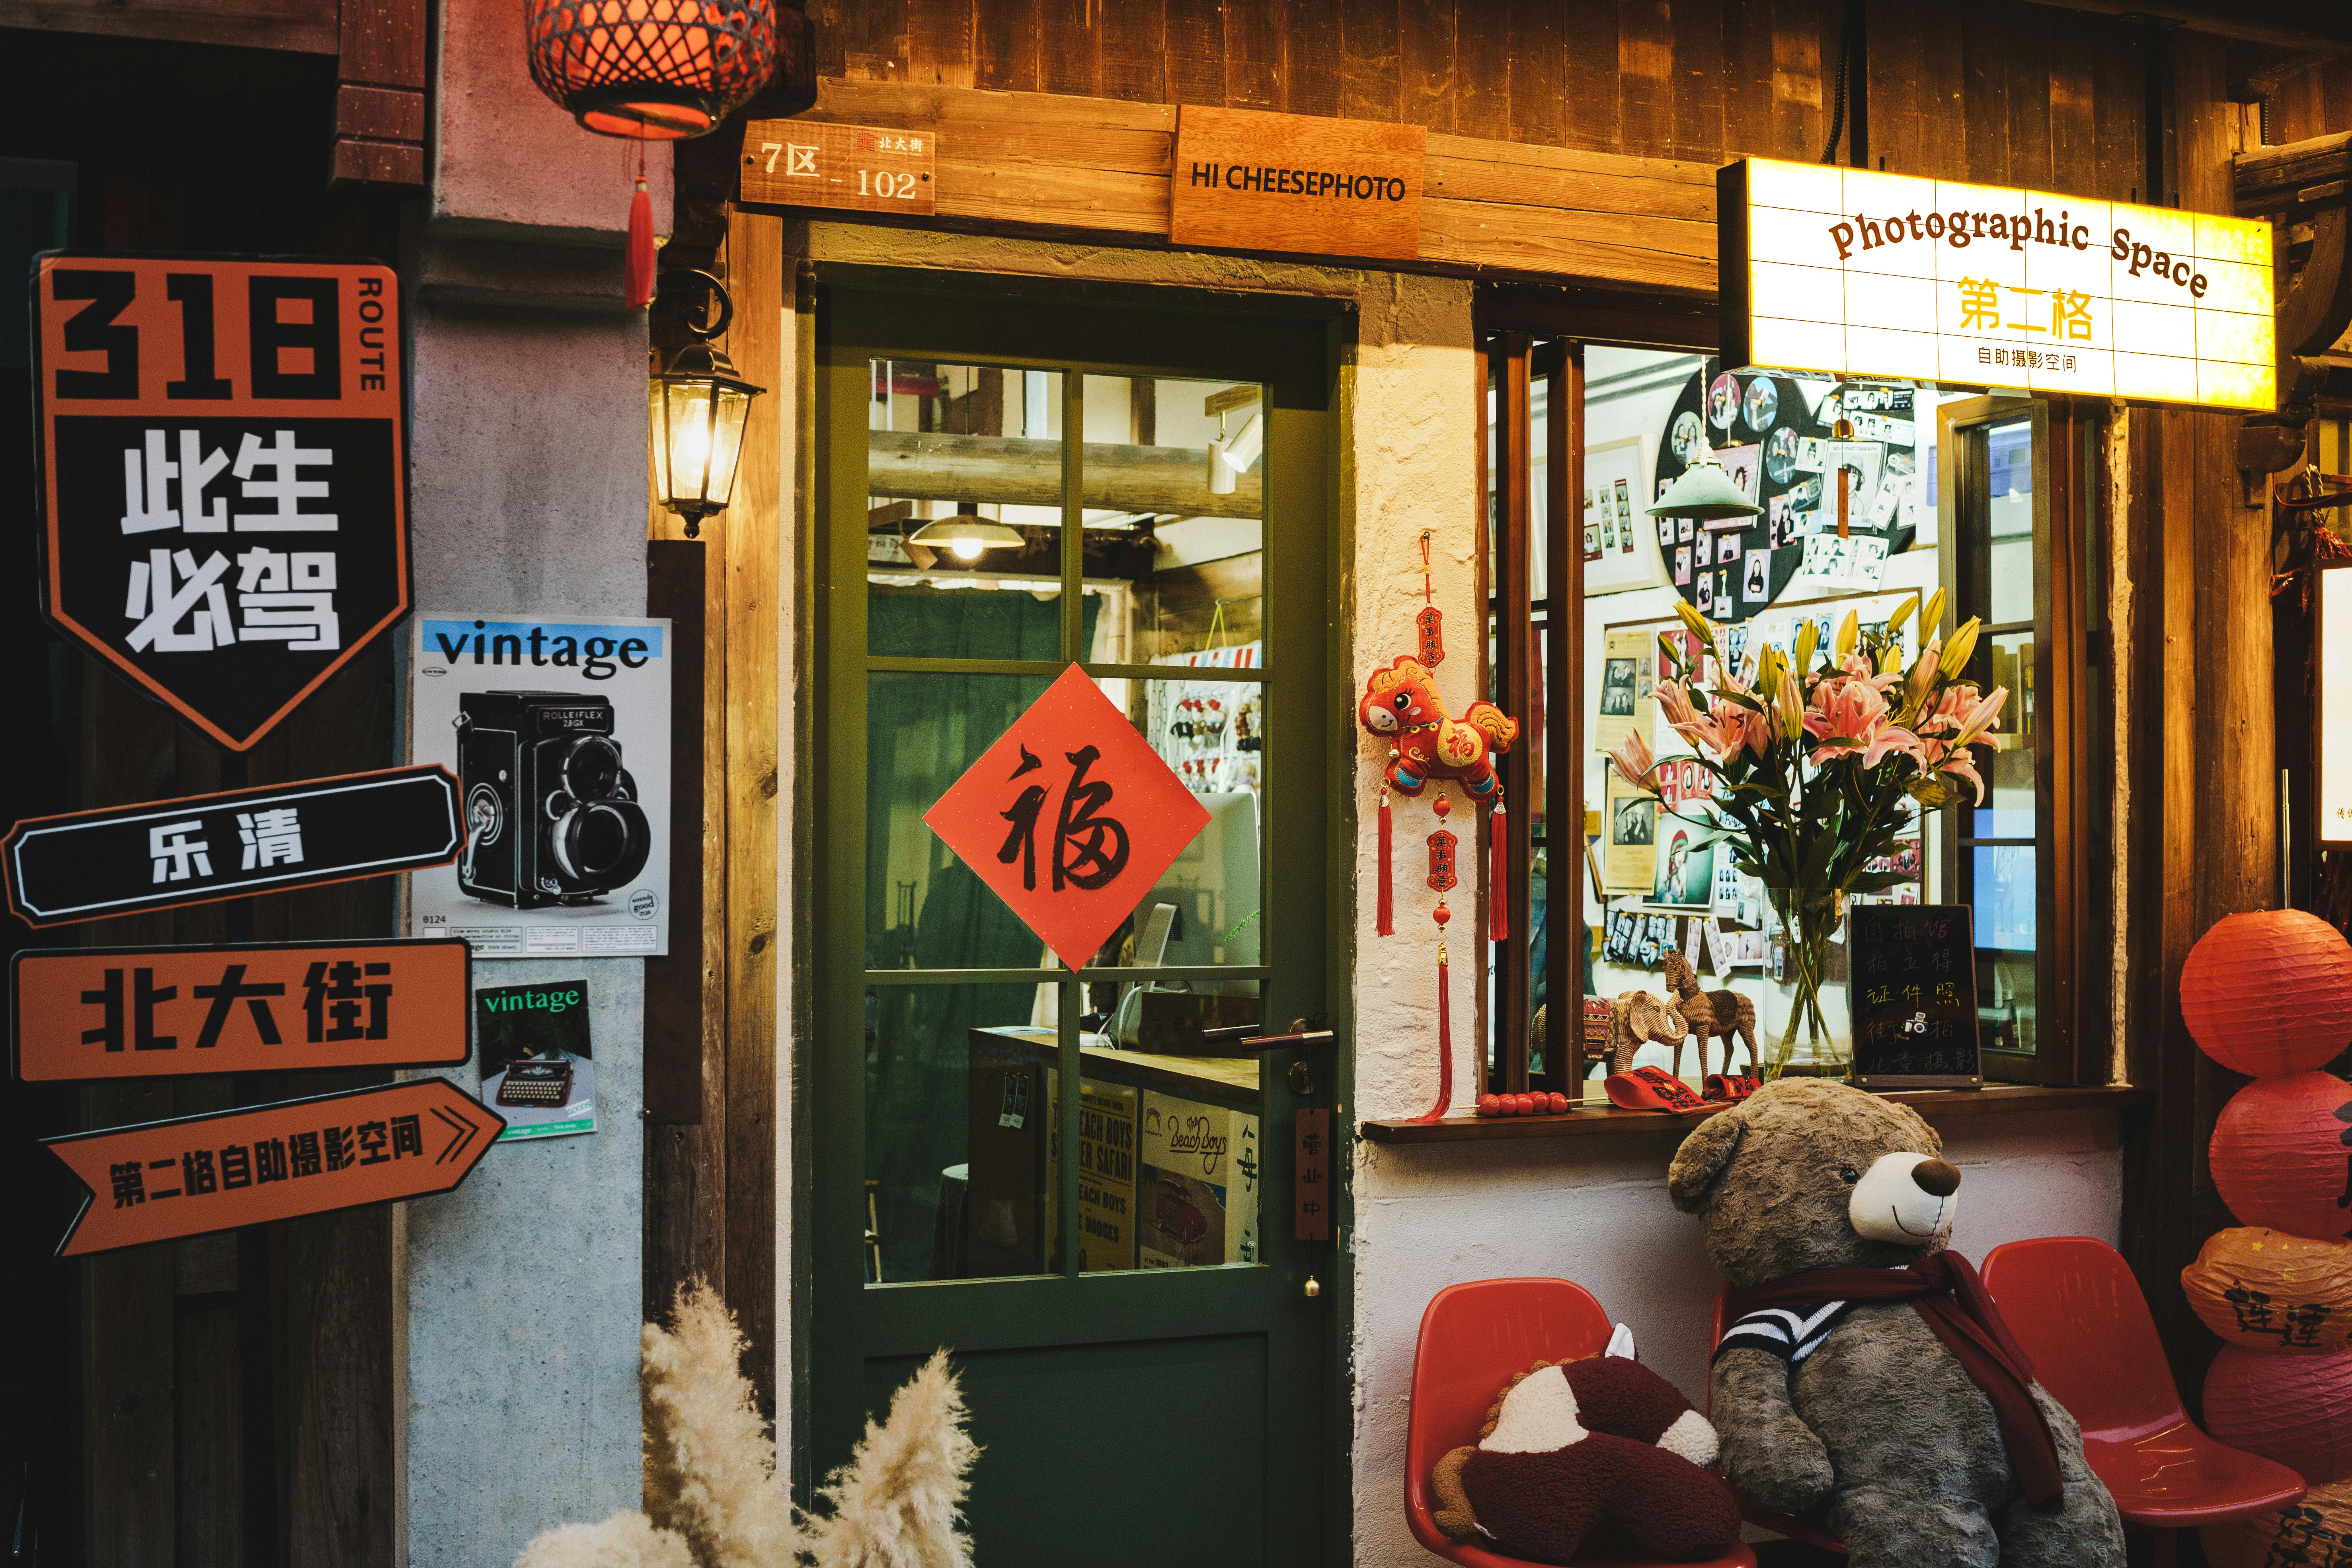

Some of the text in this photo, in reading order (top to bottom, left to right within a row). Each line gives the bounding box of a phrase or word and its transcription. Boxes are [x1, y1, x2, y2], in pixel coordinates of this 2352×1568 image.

[761, 141, 821, 177] 7区
[879, 136, 923, 153] 北大街
[857, 170, 915, 199] 102
[1191, 162, 1406, 202] HI CHEESEPHOTO
[1828, 207, 2209, 298] Photographic Space
[52, 268, 342, 400] 318
[357, 277, 386, 392] ROUTE
[1957, 275, 2094, 342] 第二格
[1977, 346, 2077, 374] 自助摄影空间
[121, 429, 339, 535] 此生
[125, 546, 340, 654] 必驾
[435, 620, 649, 680] vintage
[1423, 612, 1436, 664] 萬事勝意
[543, 711, 603, 721] ROLLEIFLEX
[1446, 727, 1475, 758] 福
[997, 742, 1130, 893] 福
[149, 808, 304, 883] 乐清
[1432, 835, 1448, 887] 萬事勝意
[80, 960, 393, 1053] 北大街
[485, 990, 579, 1013] vintage
[1867, 982, 1960, 1008] 证件照
[1079, 1110, 1103, 1142] EACH
[1106, 1117, 1132, 1150] BOYS
[1168, 1115, 1200, 1153] Beach
[1198, 1116, 1227, 1175] Boys
[1186, 1116, 1198, 1133] The
[109, 1114, 423, 1209] 第二格自助摄影空间
[1096, 1145, 1133, 1182] SAFARI
[1302, 1133, 1322, 1216] 营业中
[1079, 1184, 1126, 1215] EACH BOYS
